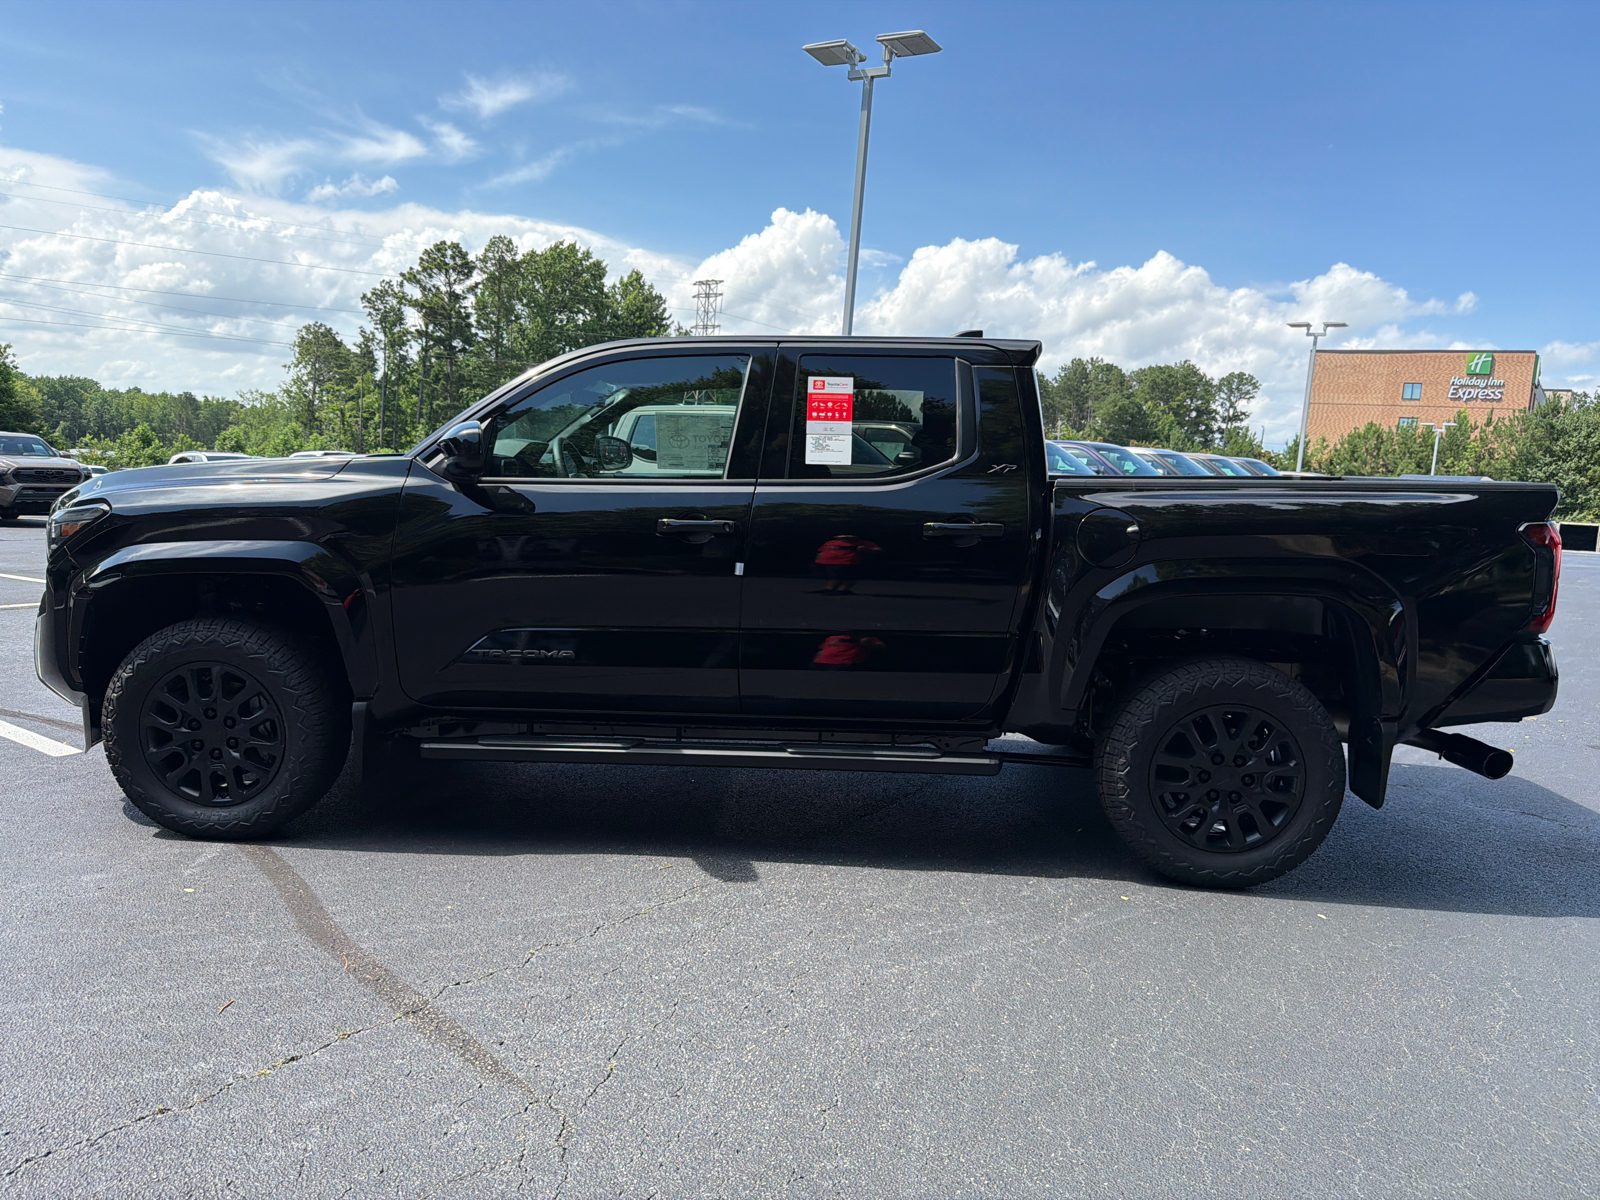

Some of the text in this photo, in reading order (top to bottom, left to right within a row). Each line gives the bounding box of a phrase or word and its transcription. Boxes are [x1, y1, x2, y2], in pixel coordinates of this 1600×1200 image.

[1450, 376, 1504, 387] Holiday Inn
[1448, 386, 1503, 401] Express
[472, 649, 575, 658] TACOMA
